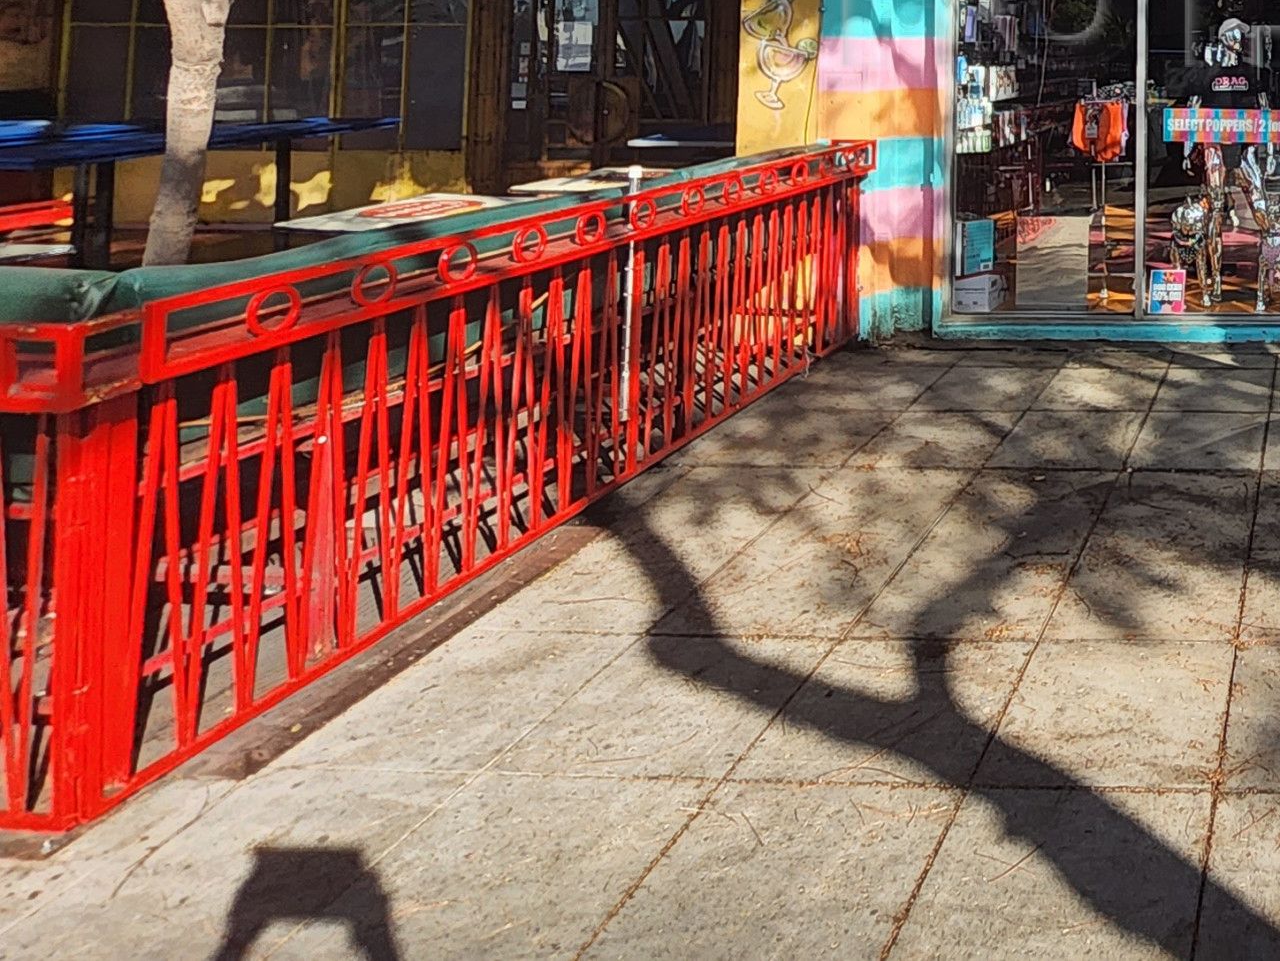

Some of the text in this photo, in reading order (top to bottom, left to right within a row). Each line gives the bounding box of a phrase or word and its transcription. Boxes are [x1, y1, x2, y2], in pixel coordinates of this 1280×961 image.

[1167, 119, 1203, 131] SELECT
[1206, 118, 1251, 132] POPPERS
[1258, 119, 1266, 132] 2
